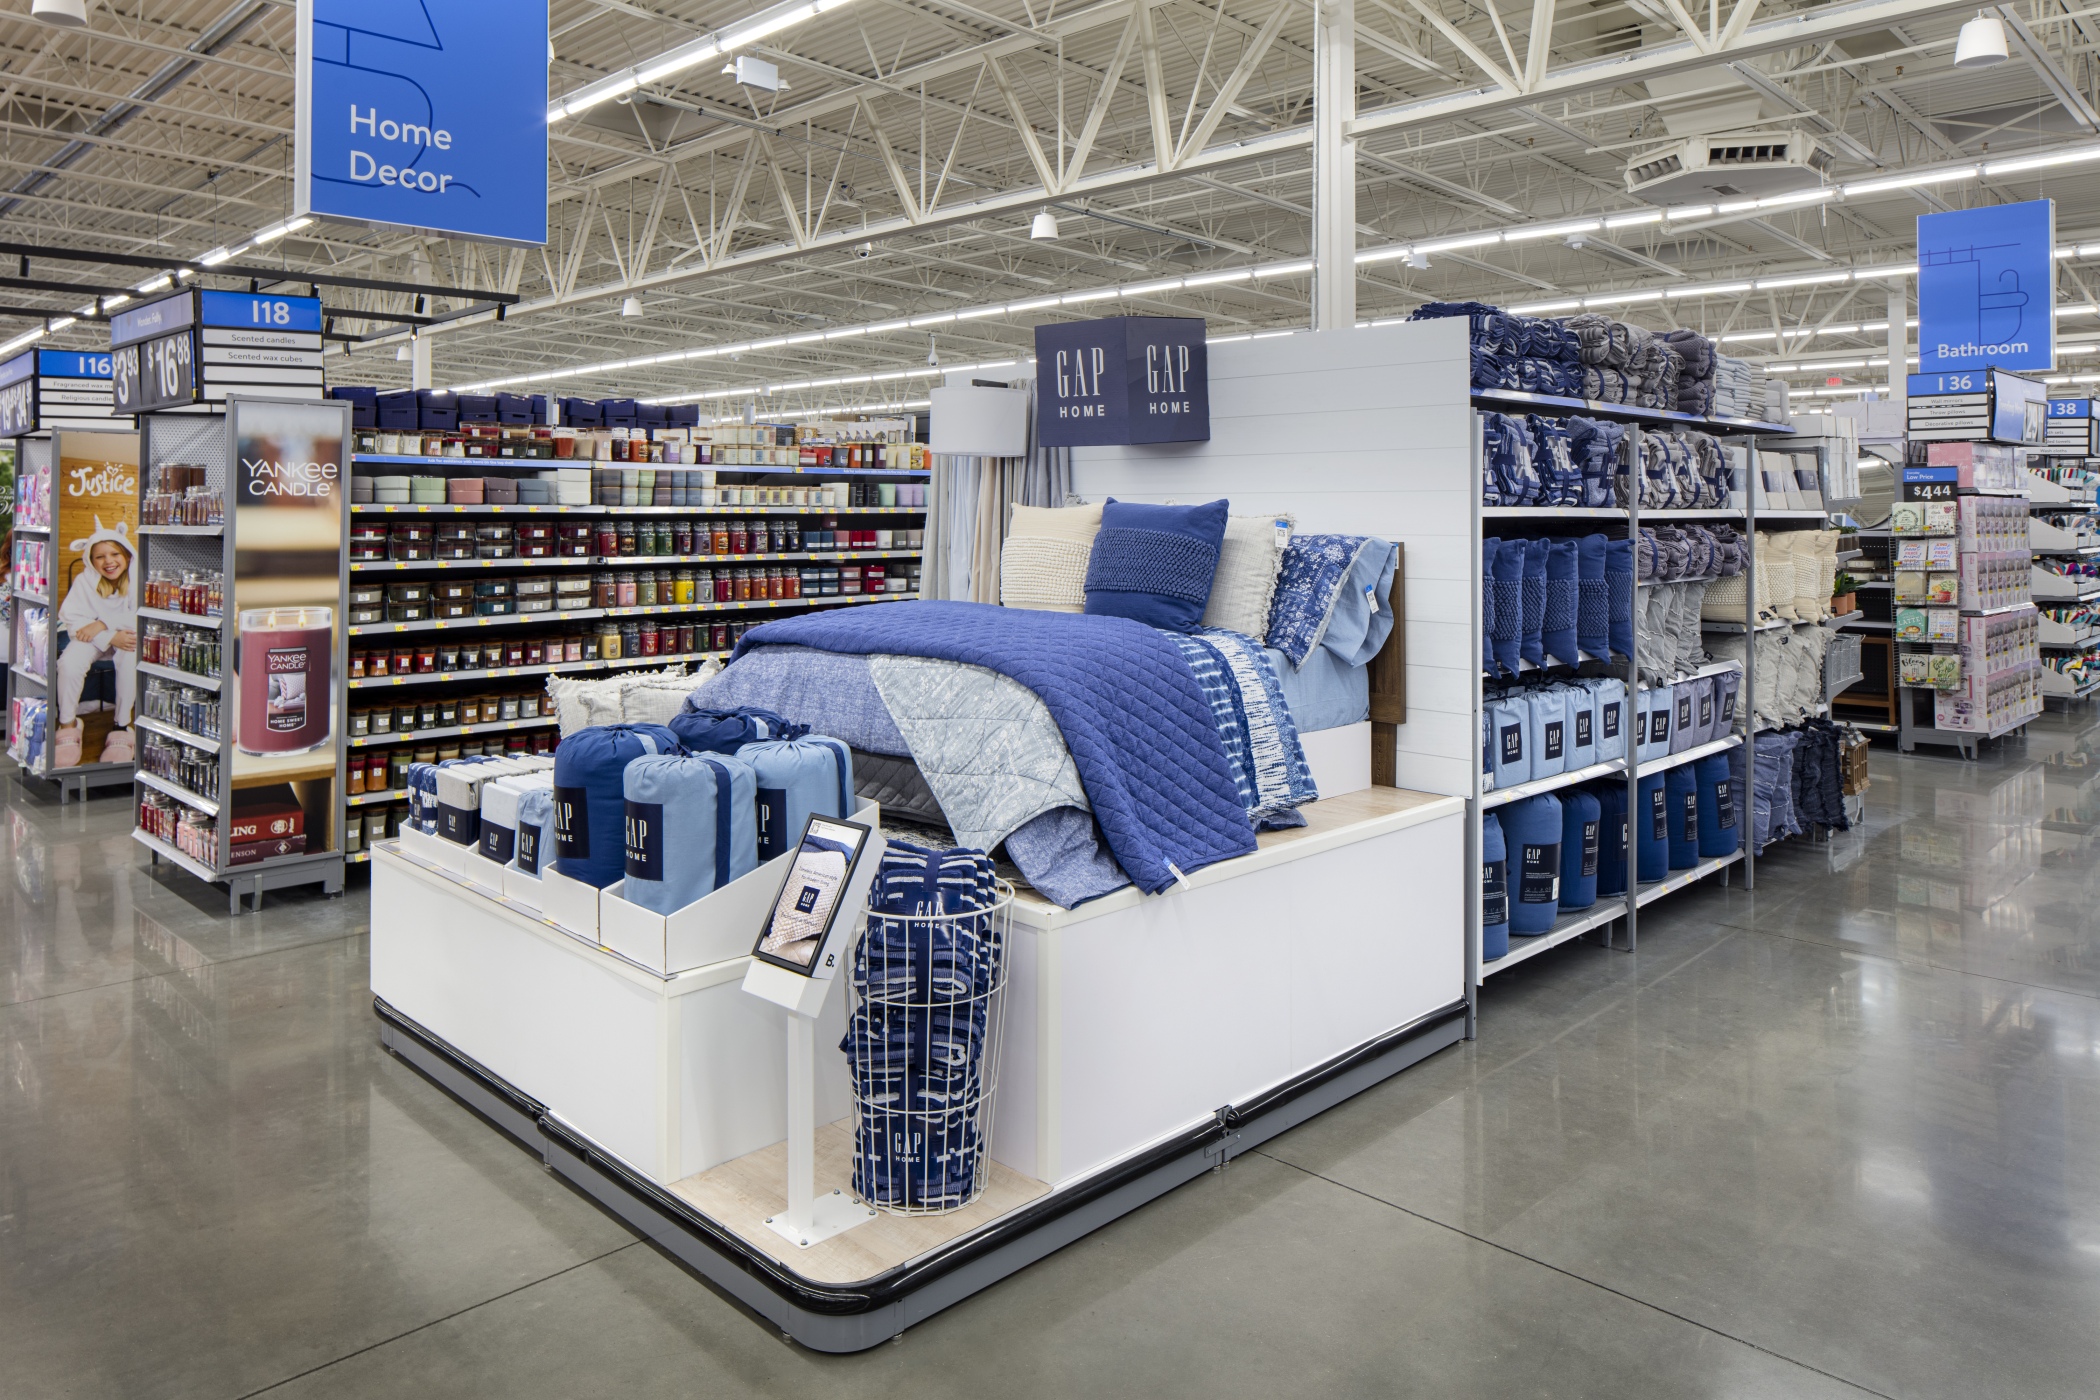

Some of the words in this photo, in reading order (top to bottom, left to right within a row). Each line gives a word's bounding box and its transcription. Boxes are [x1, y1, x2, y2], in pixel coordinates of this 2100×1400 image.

[351, 104, 452, 150] Home
[351, 150, 452, 193] Decor
[232, 334, 264, 342] Scented
[266, 336, 296, 344] candles
[228, 352, 260, 360] Scented
[280, 354, 302, 362] cubes
[1938, 342, 2028, 358] Bathroom
[1056, 347, 1104, 398] GAP
[1146, 344, 1190, 393] GAP
[1060, 405, 1105, 418] HOME
[1150, 402, 1190, 414] HOME
[69, 463, 134, 497] Justice
[1607, 710, 1616, 725] GAP
[1655, 717, 1666, 731] GAP
[1580, 718, 1588, 733] GAP
[1506, 732, 1518, 750] GAP
[1549, 729, 1560, 745] GAP
[1654, 791, 1663, 802] GAP
[1718, 784, 1727, 794] GAP
[1586, 824, 1595, 835] GAP
[489, 832, 498, 847] GAP
[521, 832, 534, 854] GAP
[1526, 848, 1541, 860] GAP
[802, 891, 815, 904] GAP
[915, 901, 943, 917] GAP
[894, 1132, 921, 1154] GAP
